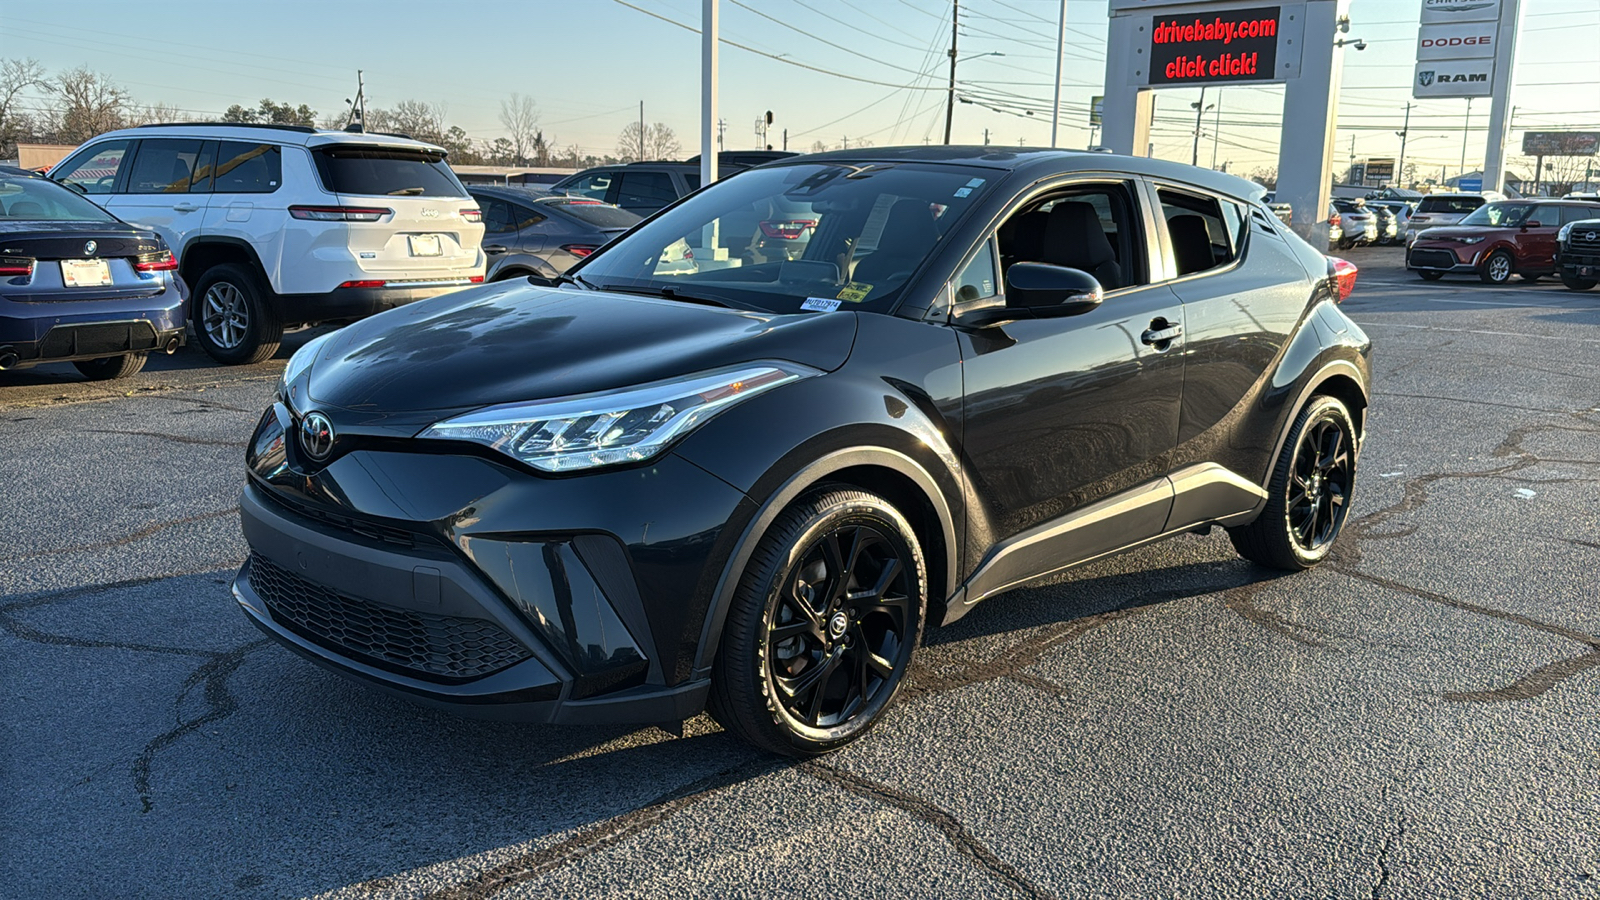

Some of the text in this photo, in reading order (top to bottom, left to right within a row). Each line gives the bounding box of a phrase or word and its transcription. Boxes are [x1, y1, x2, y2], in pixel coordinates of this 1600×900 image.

[1153, 17, 1276, 44] drivebaby.com
[1421, 36, 1491, 47] DODGE
[1165, 52, 1258, 78] click click!
[1437, 74, 1487, 83] RAM
